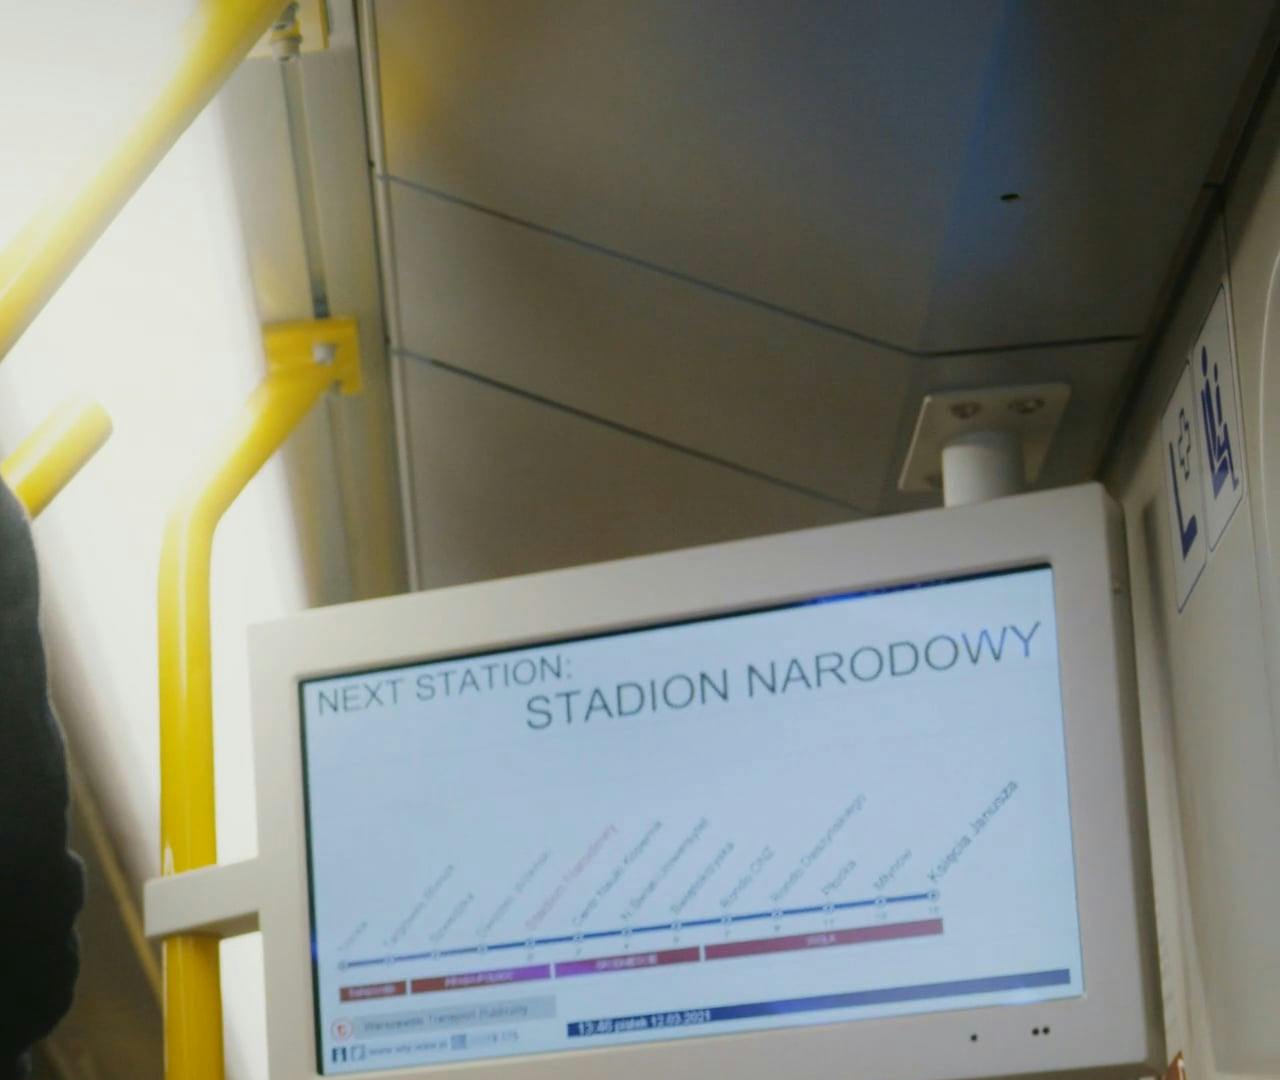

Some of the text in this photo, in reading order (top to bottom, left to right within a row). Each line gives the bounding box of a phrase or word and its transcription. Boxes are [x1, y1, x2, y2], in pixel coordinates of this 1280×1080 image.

[317, 654, 573, 716] NEXT STATION:
[525, 620, 1042, 731] STADION NARODOWY
[970, 780, 1018, 835] Janusza
